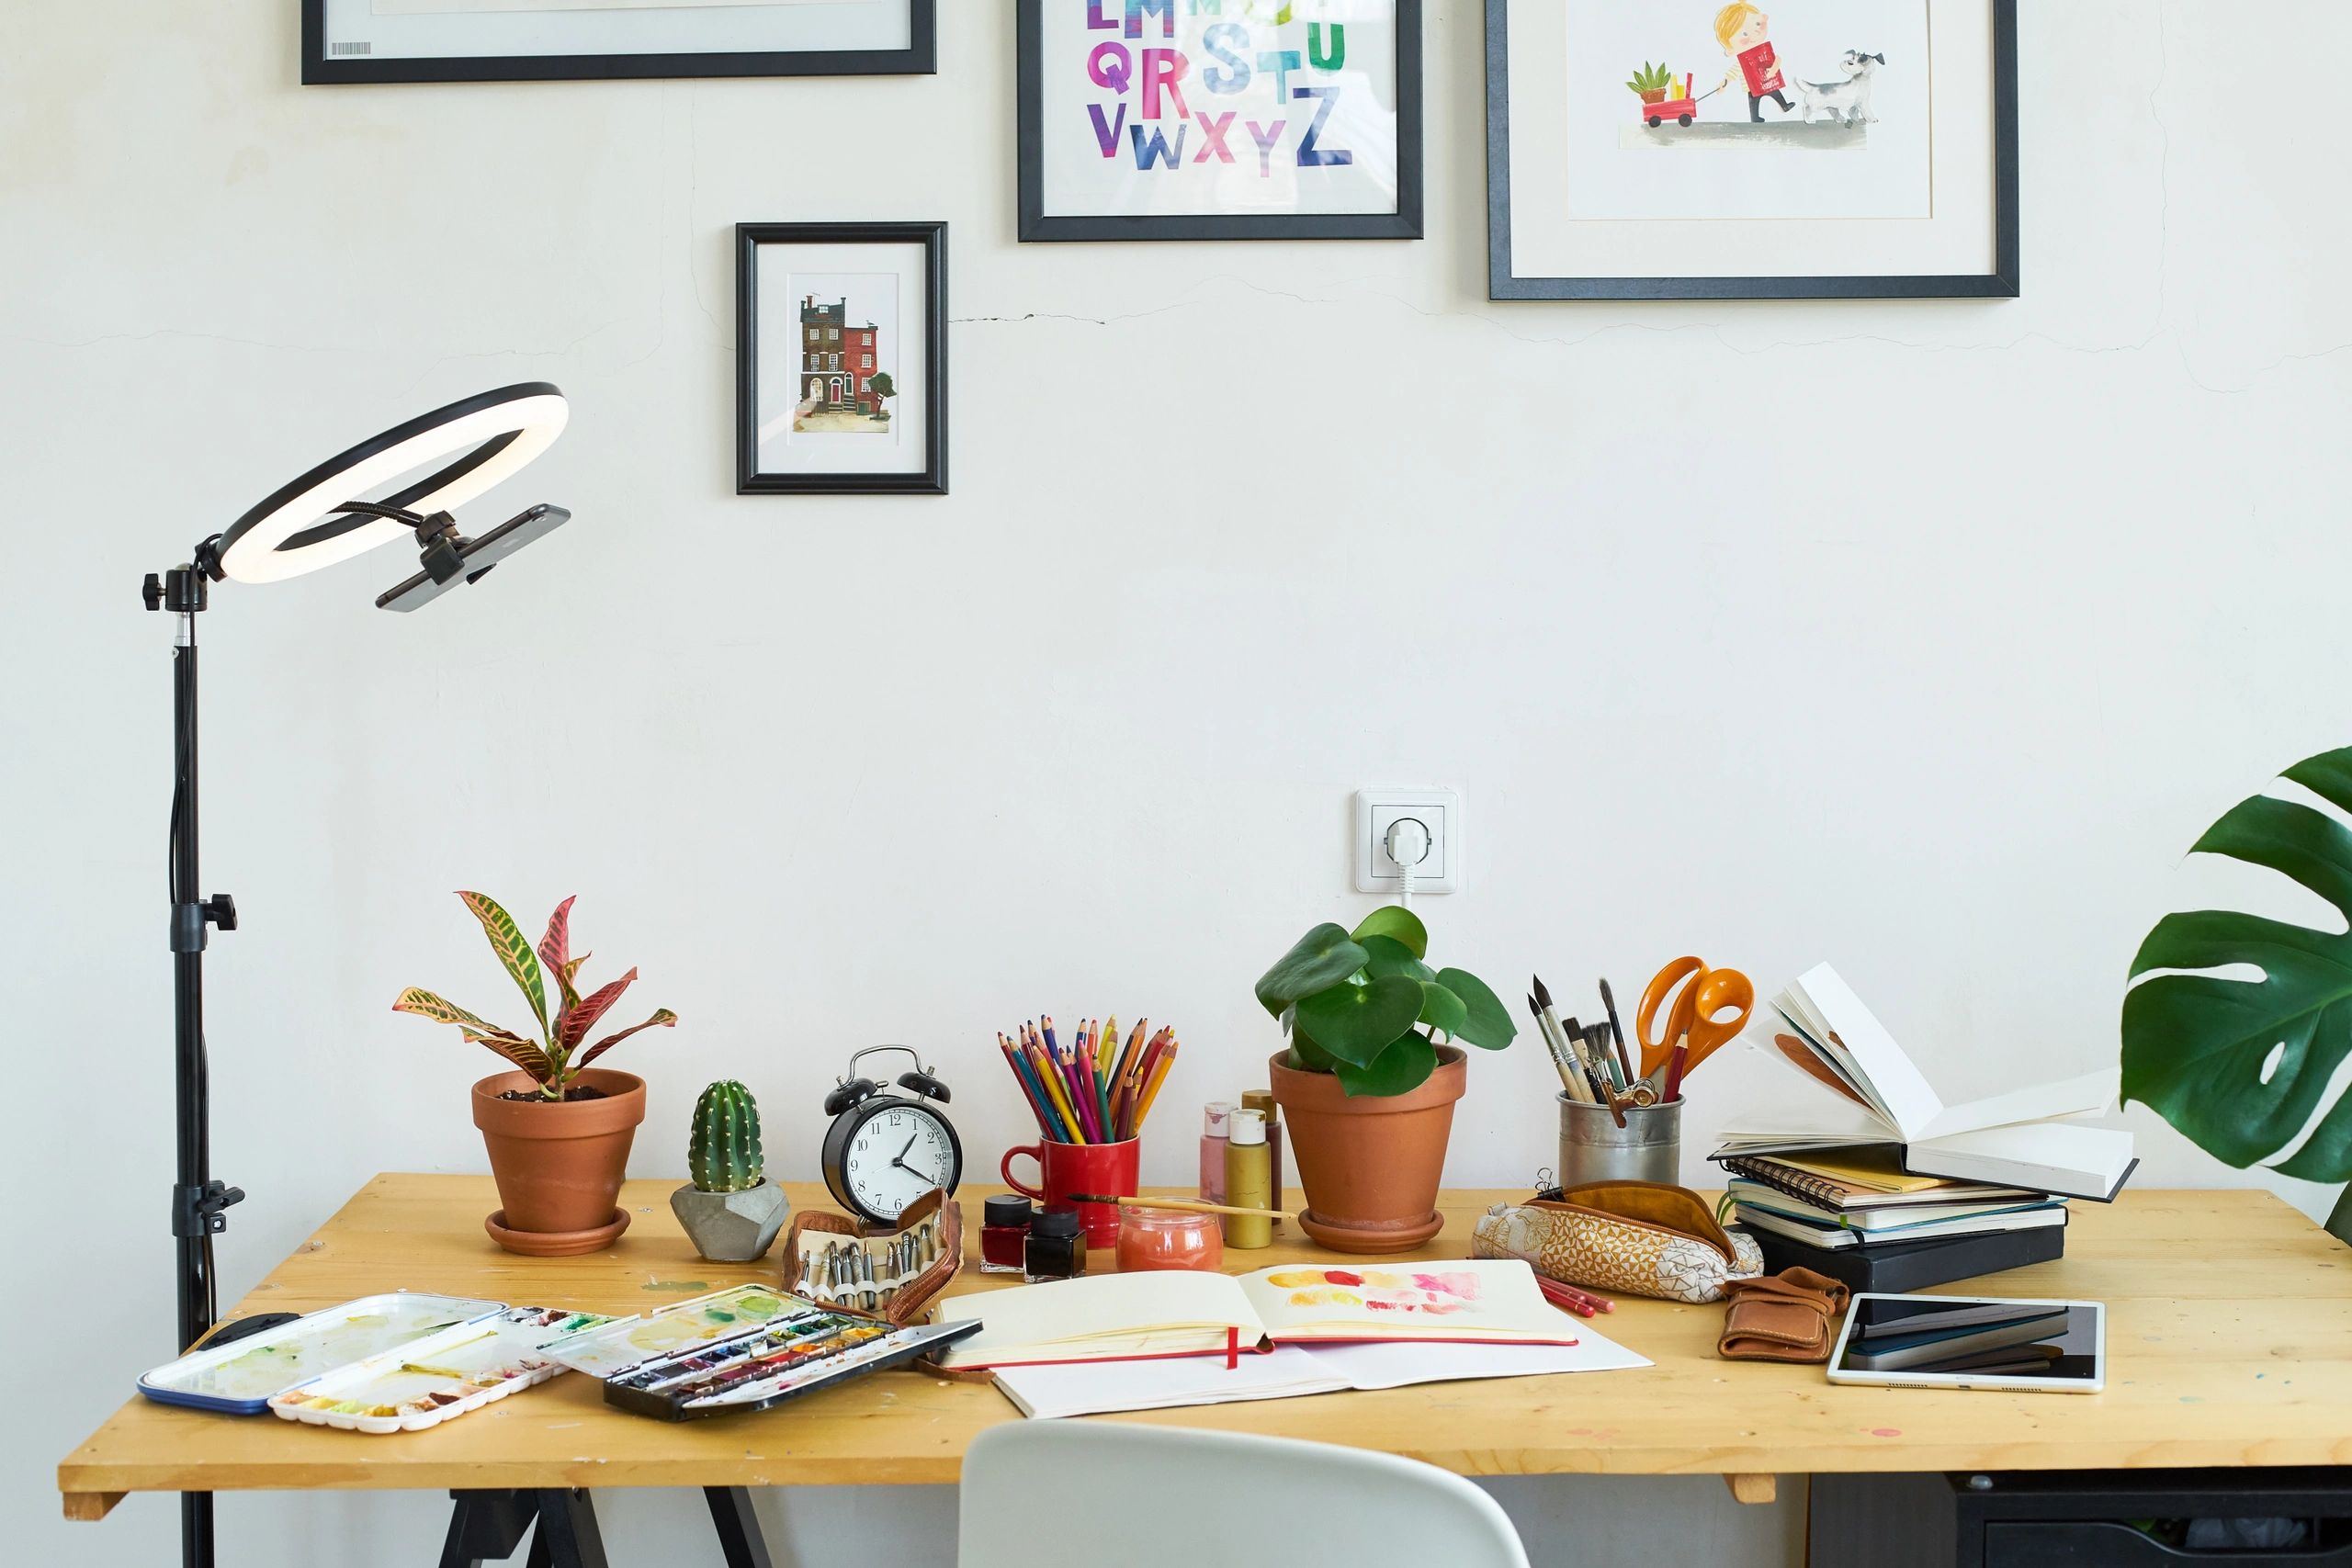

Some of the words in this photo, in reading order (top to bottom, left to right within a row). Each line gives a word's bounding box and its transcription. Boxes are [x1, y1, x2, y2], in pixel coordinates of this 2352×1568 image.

[1087, 41, 1132, 95] Q
[1142, 49, 1191, 119] R
[1203, 23, 1251, 95] S
[1257, 51, 1301, 105] T
[1307, 22, 1345, 76] U
[1087, 103, 1126, 158] V
[1193, 111, 1237, 164] X
[1246, 120, 1286, 177] Y
[1293, 86, 1352, 166] Z
[888, 1114, 901, 1126] 12
[912, 1118, 918, 1131] 1
[871, 1122, 880, 1134] 11
[927, 1132, 935, 1144] 2
[857, 1139, 868, 1151] 10
[934, 1153, 942, 1165] 3
[850, 1159, 858, 1172] 9
[858, 1180, 866, 1192] 8
[875, 1193, 882, 1206] 7
[894, 1198, 902, 1211] 6
